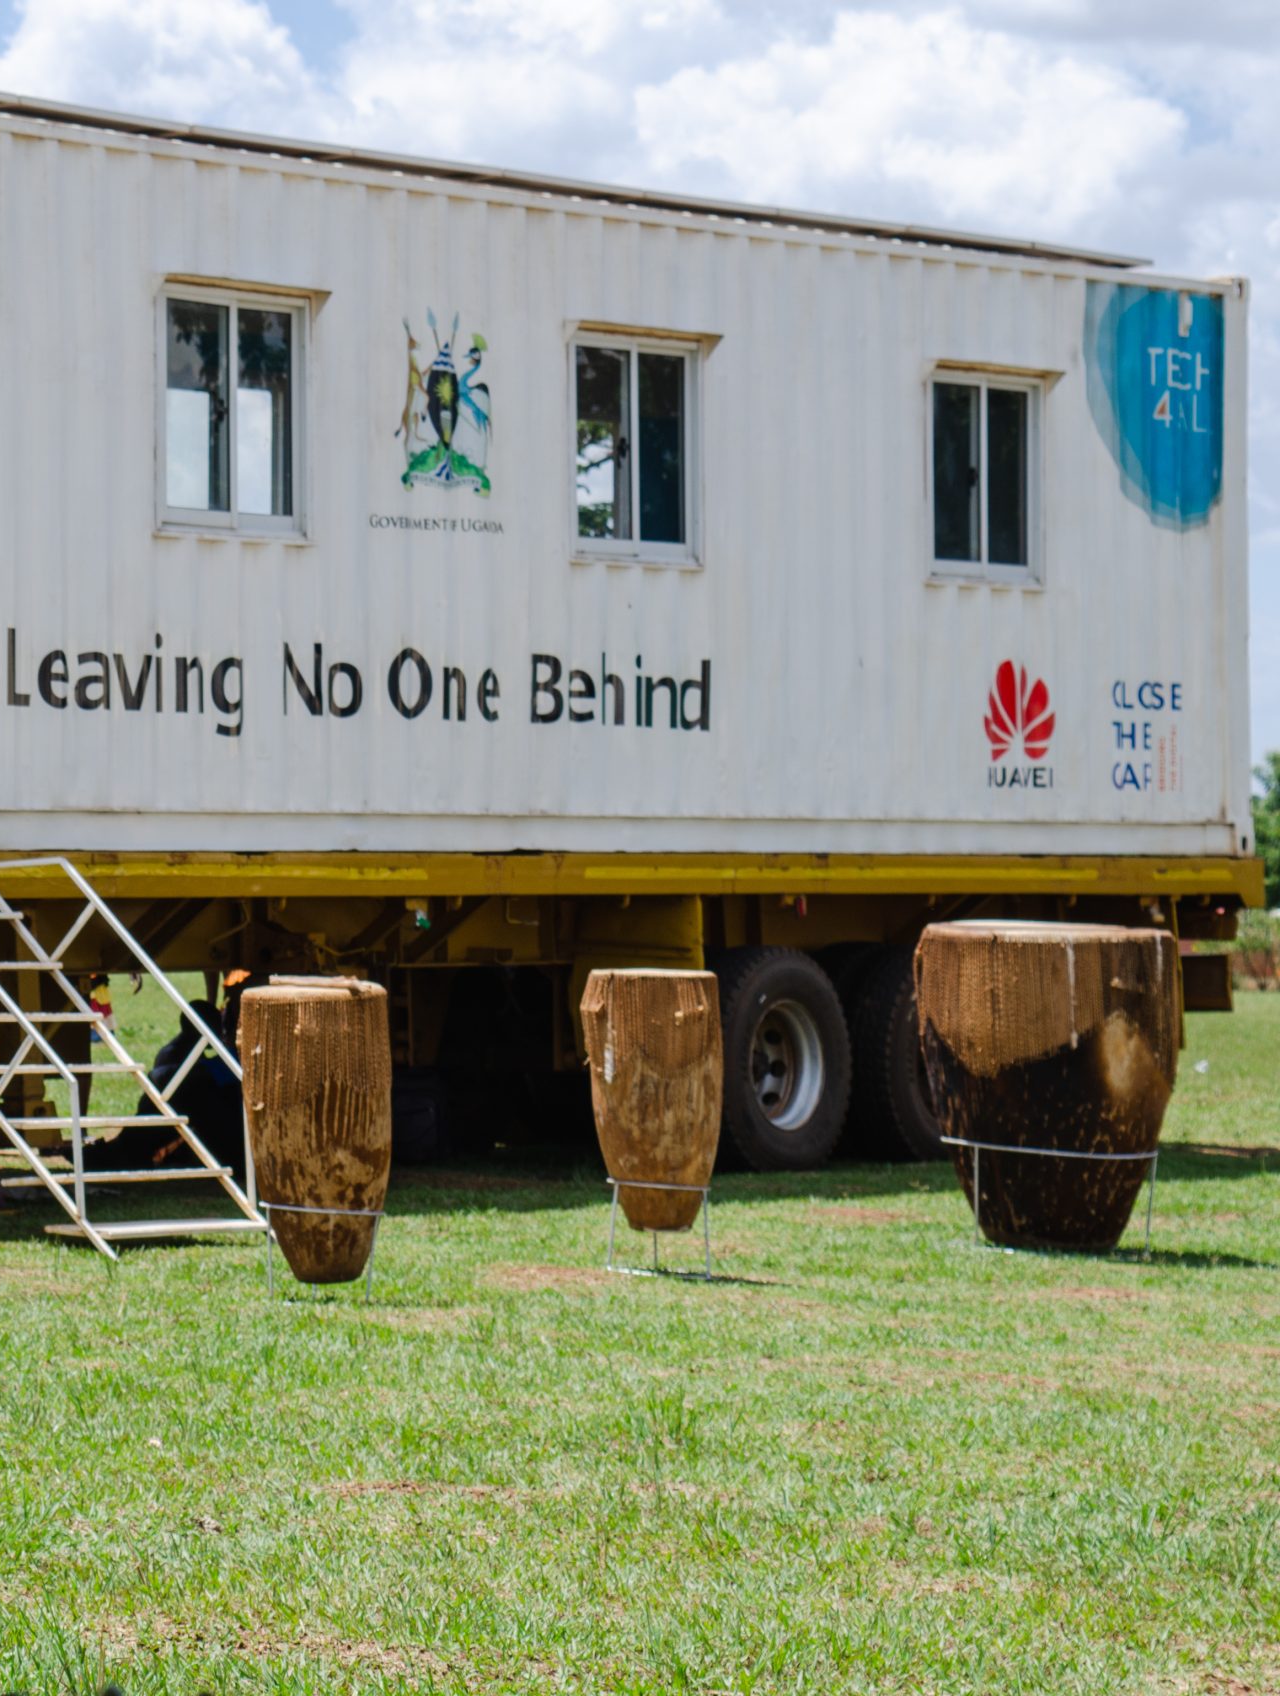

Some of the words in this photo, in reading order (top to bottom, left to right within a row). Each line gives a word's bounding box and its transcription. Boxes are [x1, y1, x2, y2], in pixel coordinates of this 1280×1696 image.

[7, 627, 243, 737] Leaving
[283, 641, 363, 718] No
[387, 647, 500, 722] One
[530, 651, 711, 731] Behind
[1111, 721, 1152, 751] THE
